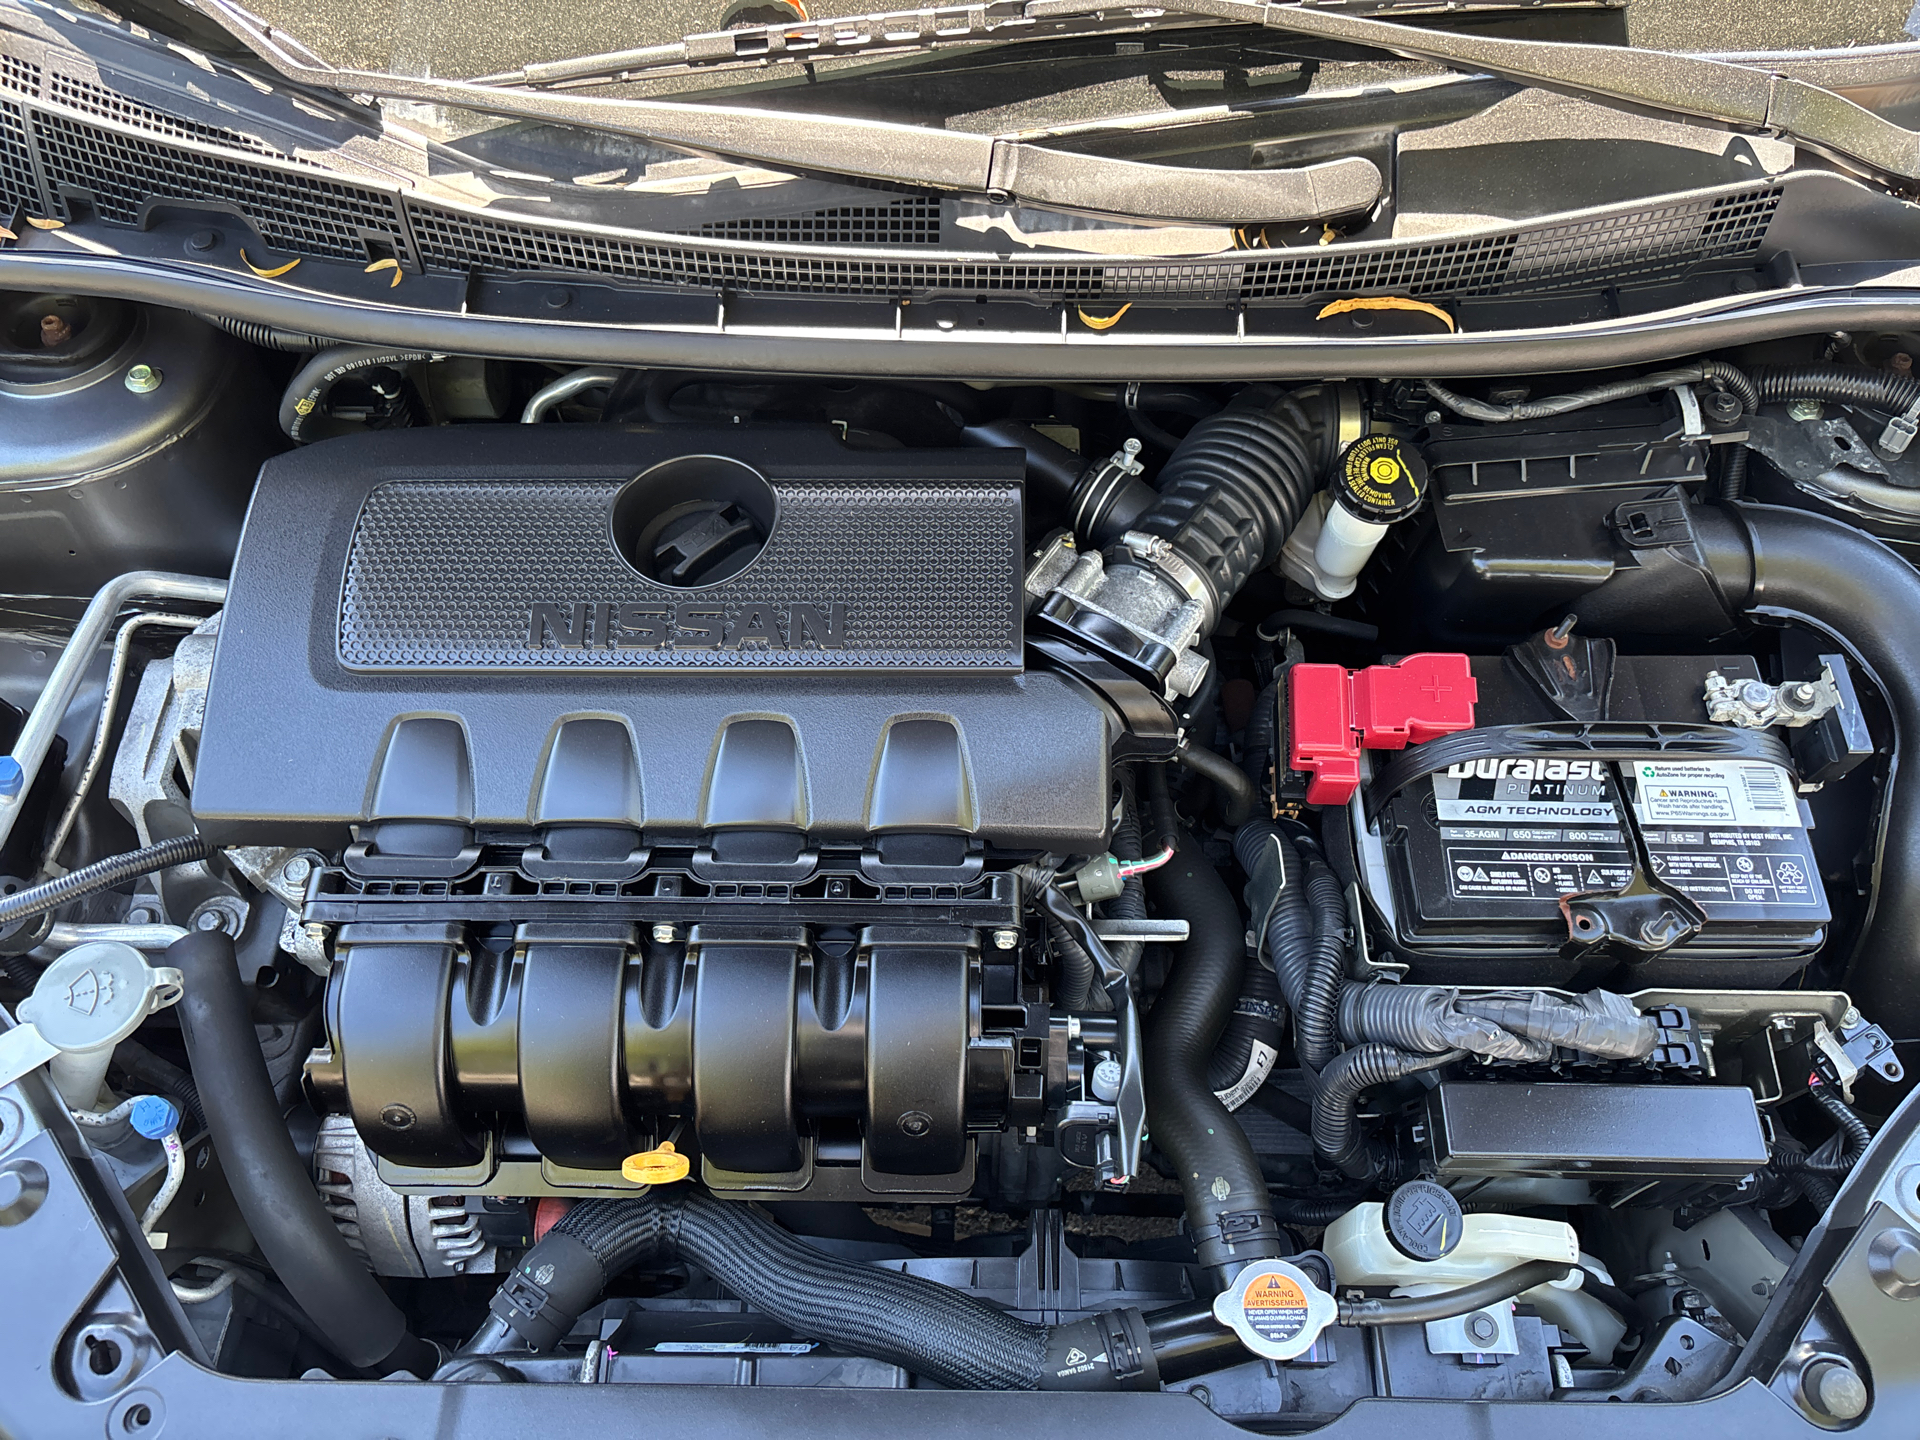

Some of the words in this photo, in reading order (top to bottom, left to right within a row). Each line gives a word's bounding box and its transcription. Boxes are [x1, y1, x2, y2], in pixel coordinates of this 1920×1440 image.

[1372, 436, 1386, 444] ONLY
[1388, 437, 1398, 445] USE
[1347, 447, 1359, 462] FLUID
[1358, 444, 1375, 457] FILLER
[1353, 457, 1362, 468] CAP
[1353, 468, 1366, 488] BEFORE
[1348, 480, 1365, 497] SEALED
[1362, 485, 1392, 499] REMOVING
[1364, 494, 1395, 506] CONTAINER
[529, 602, 845, 650] NISSAN
[1506, 783, 1606, 796] PLATINUM
[1669, 790, 1718, 798] WARNING:
[1465, 806, 1501, 814] AGM
[1507, 806, 1613, 817] TECHNOLOGY
[1465, 830, 1499, 839] 35-AGM
[1513, 831, 1531, 839] 650
[1569, 832, 1587, 840] 800
[1671, 834, 1683, 842] 55
[1510, 852, 1594, 861] DANGER/POISON
[1257, 1050, 1267, 1068] F7
[1255, 1290, 1294, 1298] WARNING
